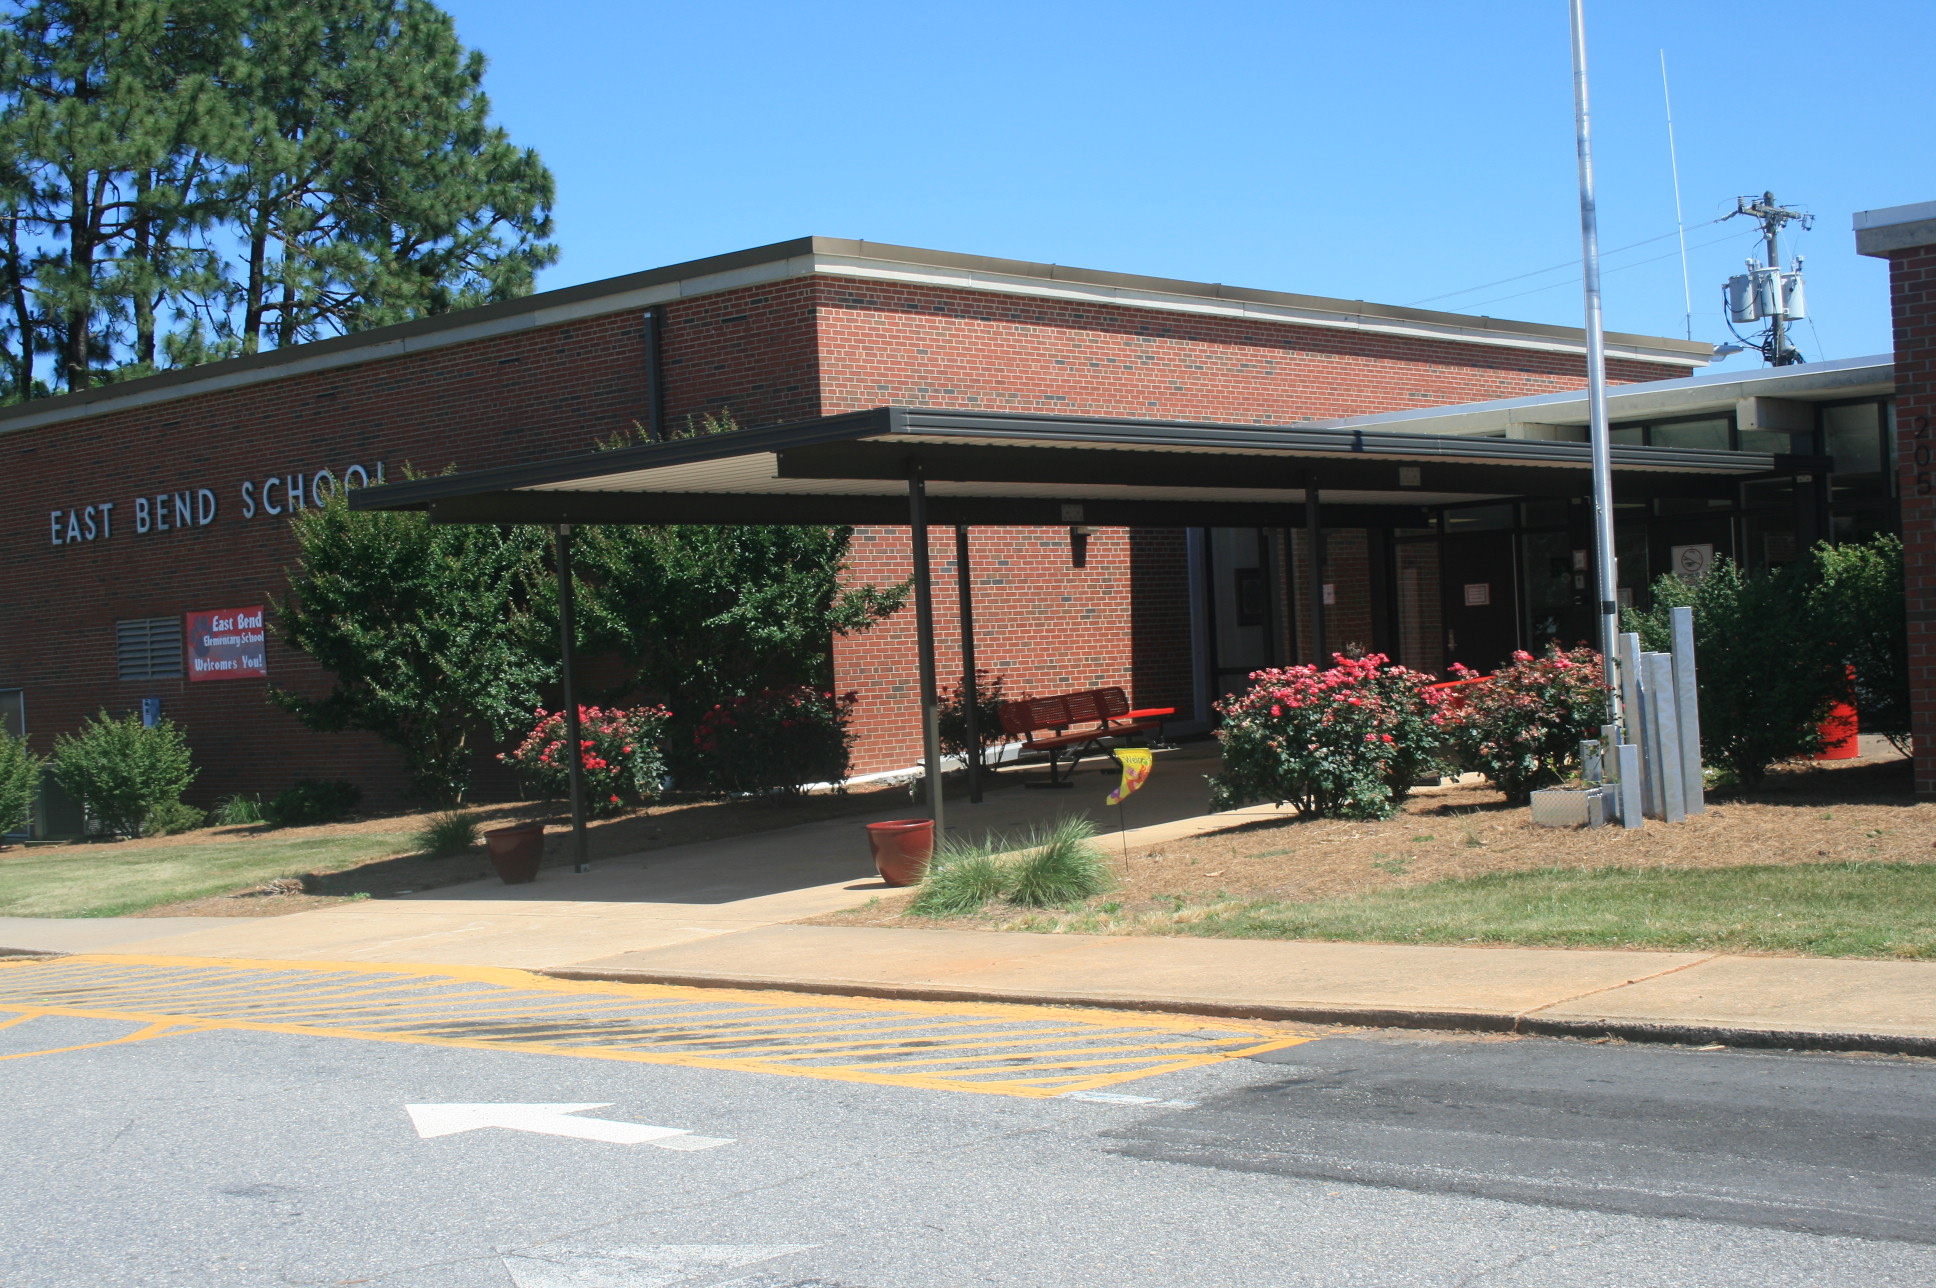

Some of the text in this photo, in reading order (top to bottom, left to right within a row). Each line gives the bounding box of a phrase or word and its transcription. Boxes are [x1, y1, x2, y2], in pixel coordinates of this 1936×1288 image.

[1914, 416, 1932, 495] 205
[51, 502, 114, 545] EAST
[135, 488, 217, 534] BEND
[213, 611, 262, 632] East Bend
[203, 630, 264, 648] Elementary School
[194, 654, 262, 671] Welcomes You!
